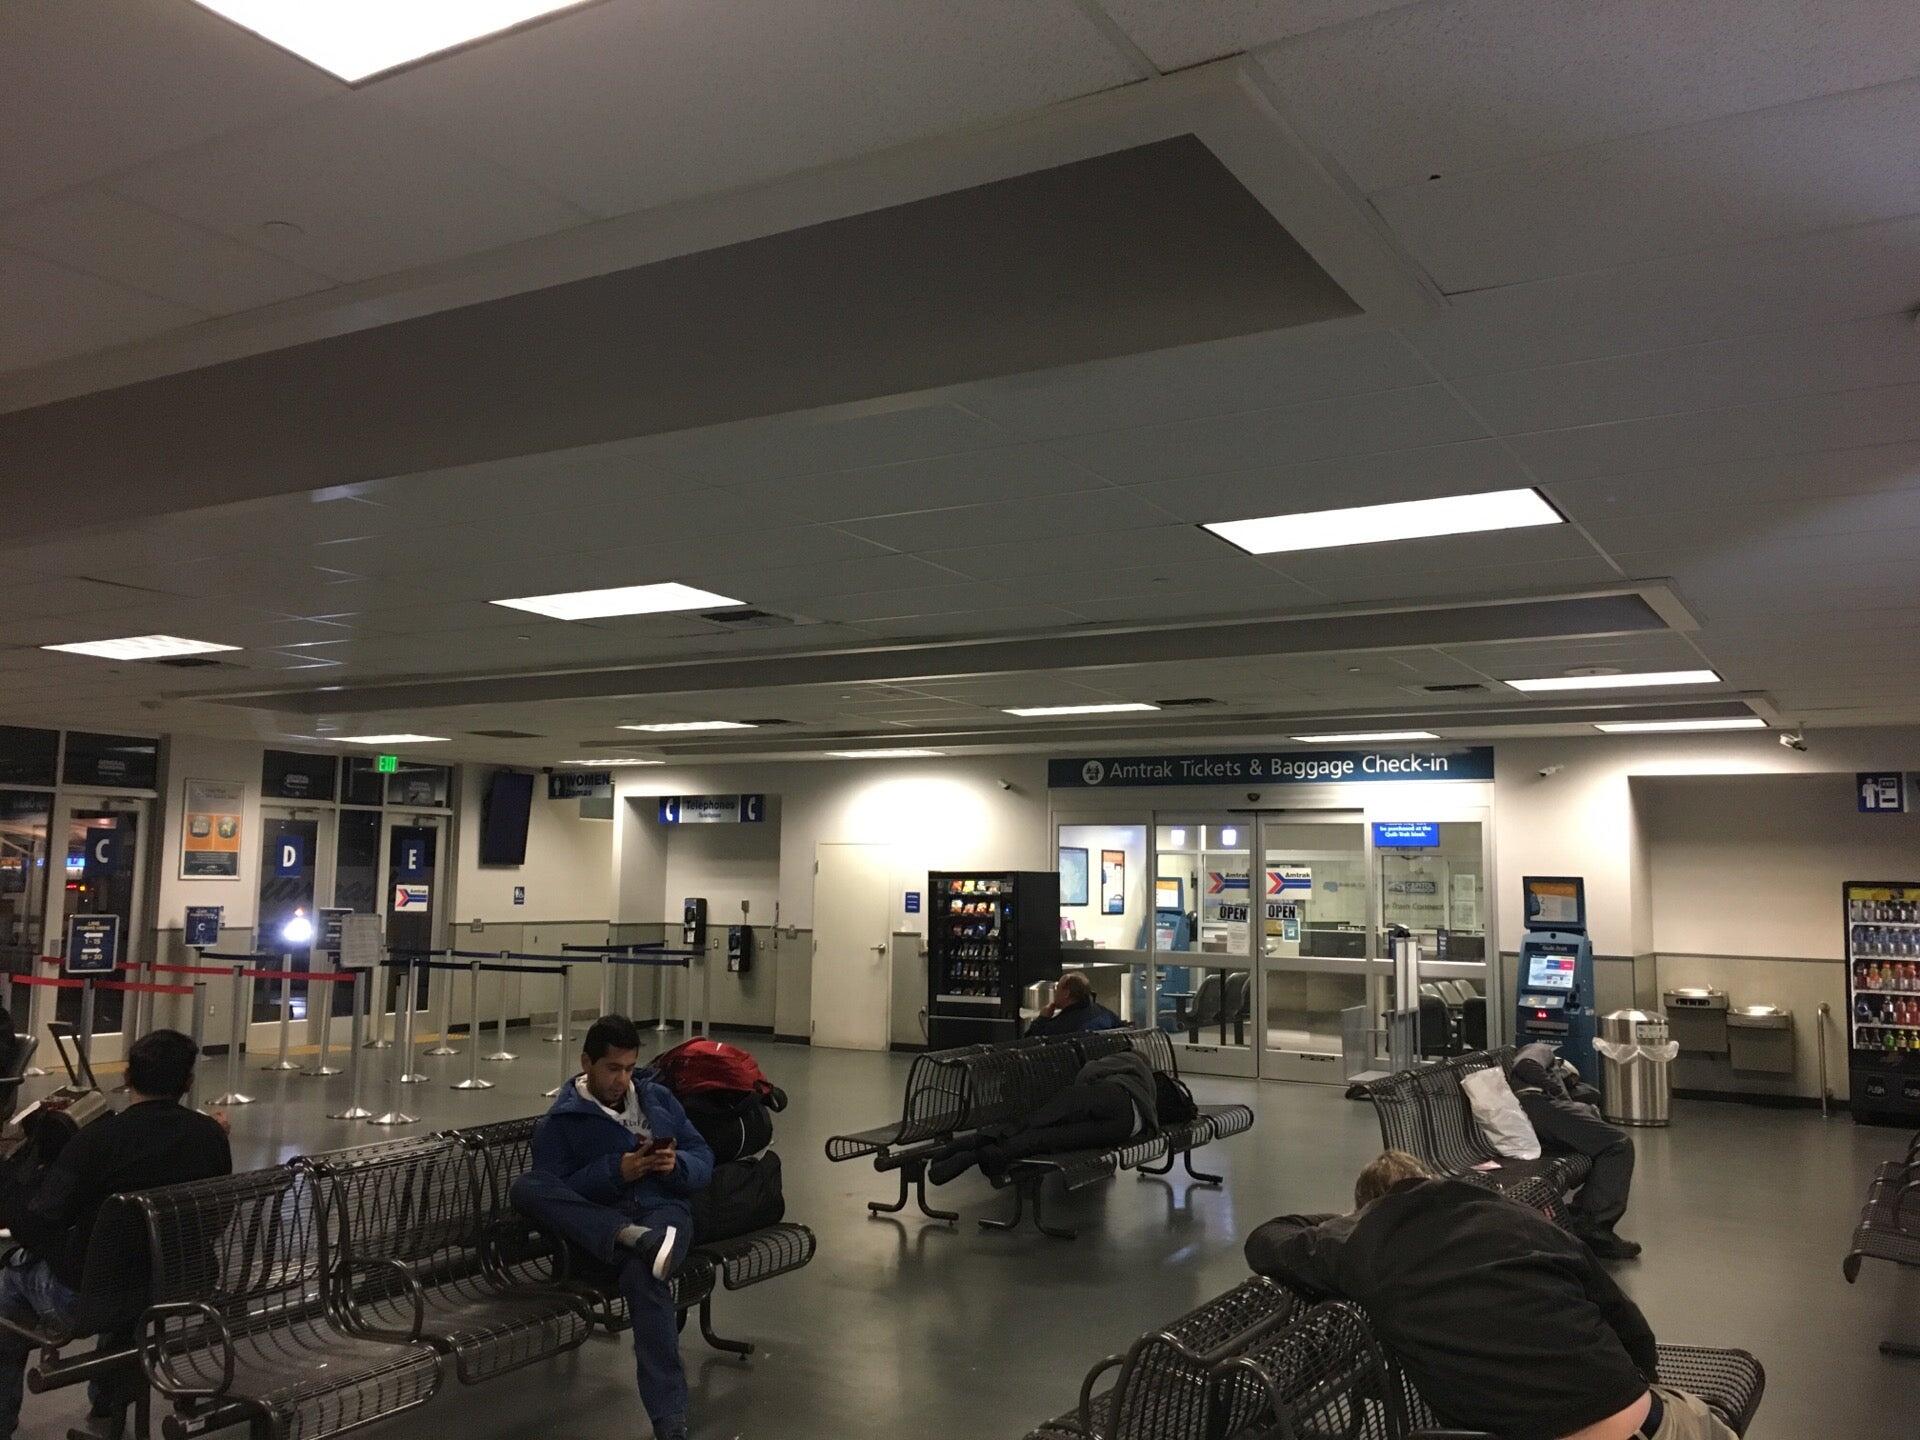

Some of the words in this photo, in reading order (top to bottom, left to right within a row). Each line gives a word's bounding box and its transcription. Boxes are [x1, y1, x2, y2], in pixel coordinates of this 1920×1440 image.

[1109, 762, 1172, 778] Amtrak
[1180, 760, 1241, 777] Tickets
[1250, 758, 1262, 776] &
[1271, 758, 1354, 779] Baggage
[1362, 753, 1448, 774] Check-in
[566, 774, 609, 786] WOMEN
[686, 800, 735, 811] Telephones
[95, 838, 110, 864] C
[282, 845, 296, 868] D
[408, 849, 417, 870] E
[1219, 905, 1248, 920] OPEN
[1268, 904, 1296, 919] OPEN
